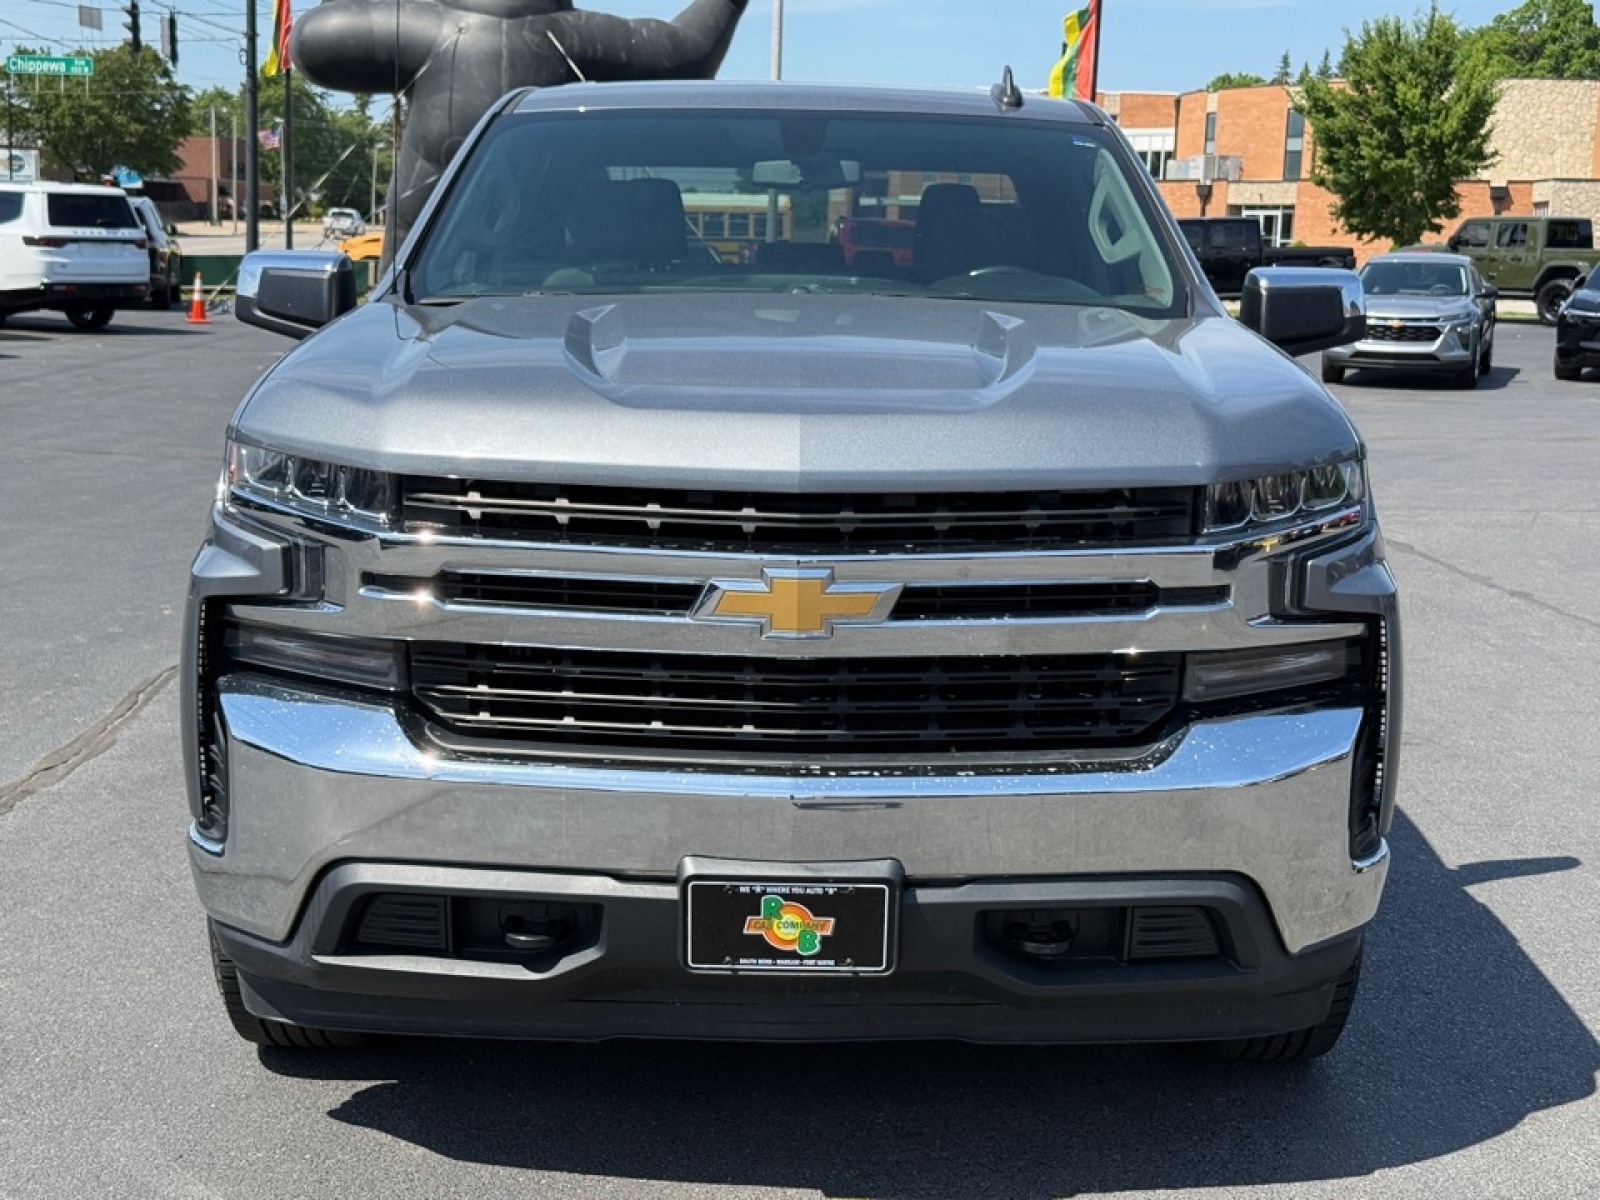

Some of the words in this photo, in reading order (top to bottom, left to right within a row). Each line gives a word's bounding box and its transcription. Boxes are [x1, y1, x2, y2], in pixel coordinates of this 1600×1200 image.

[10, 57, 66, 73] Chippewa
[761, 895, 783, 920] R
[777, 921, 824, 930] COMPANY
[796, 929, 820, 955] B
